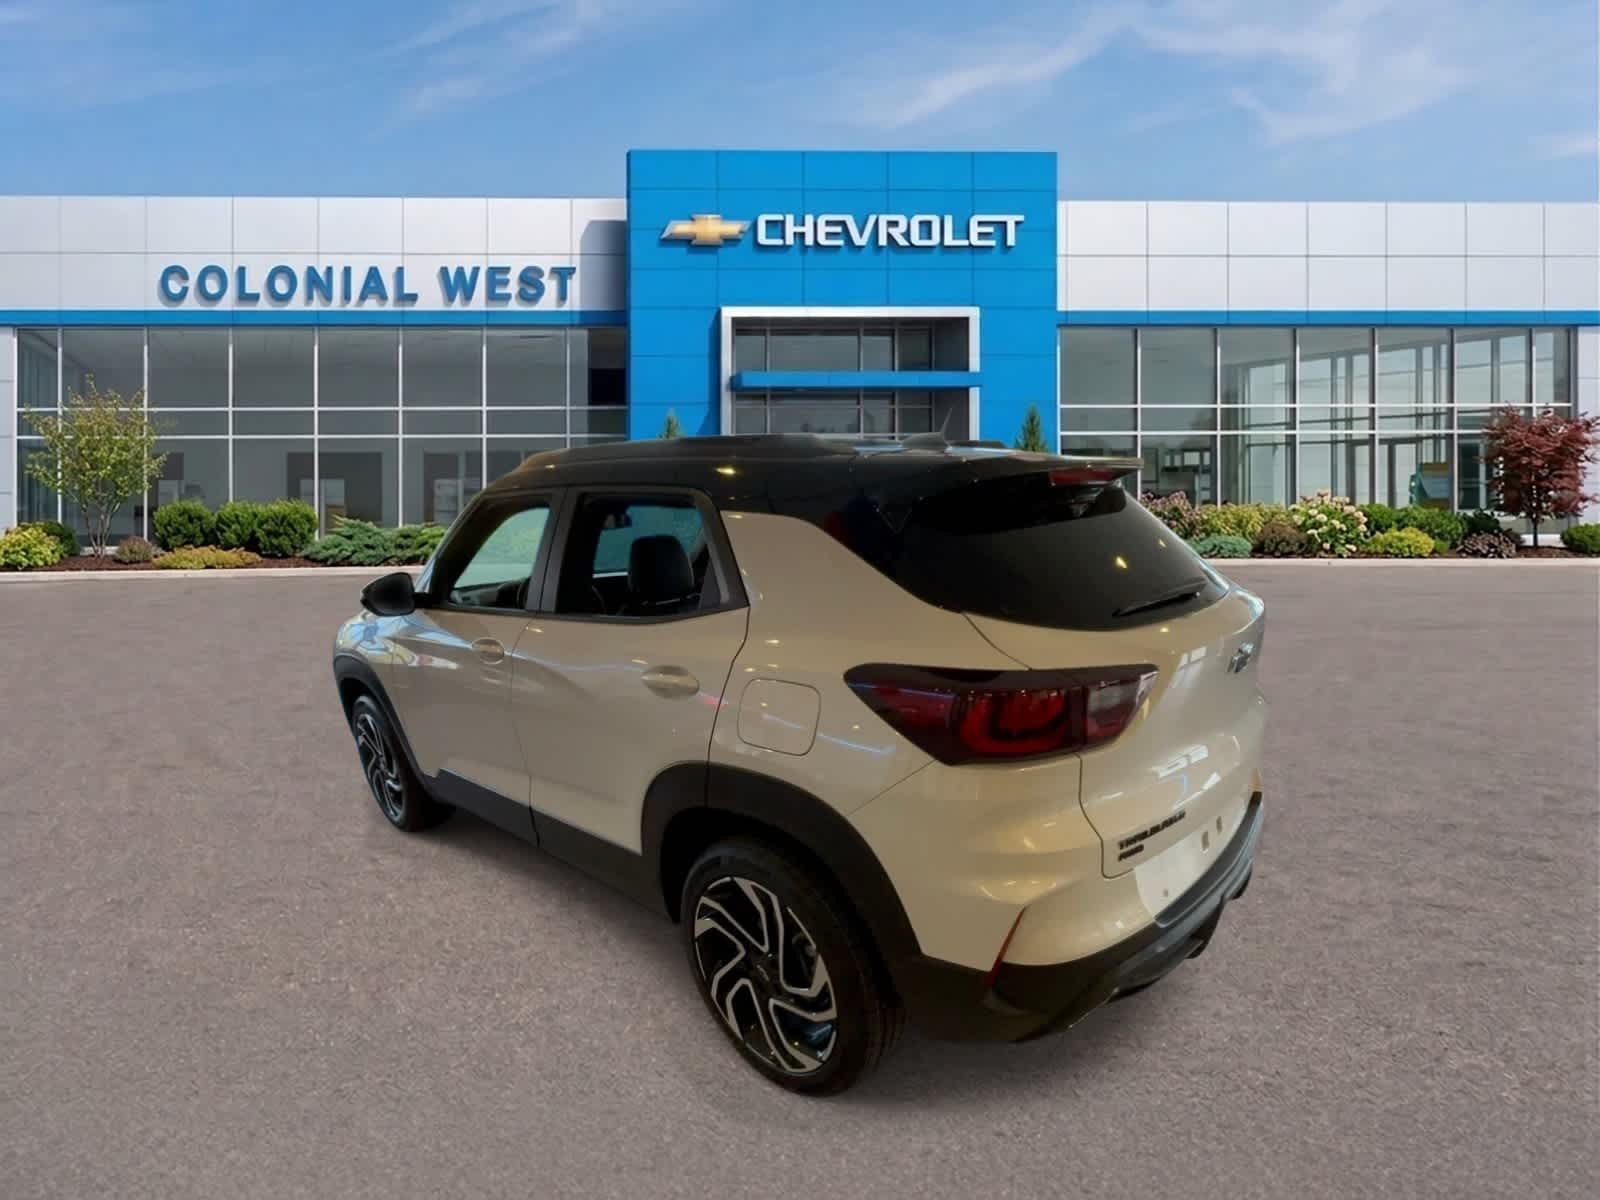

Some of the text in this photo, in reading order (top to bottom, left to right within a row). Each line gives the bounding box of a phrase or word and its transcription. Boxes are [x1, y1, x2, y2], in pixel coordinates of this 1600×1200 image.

[756, 213, 1025, 247] CHEVROLET
[159, 264, 577, 304] COLONIAL WEST
